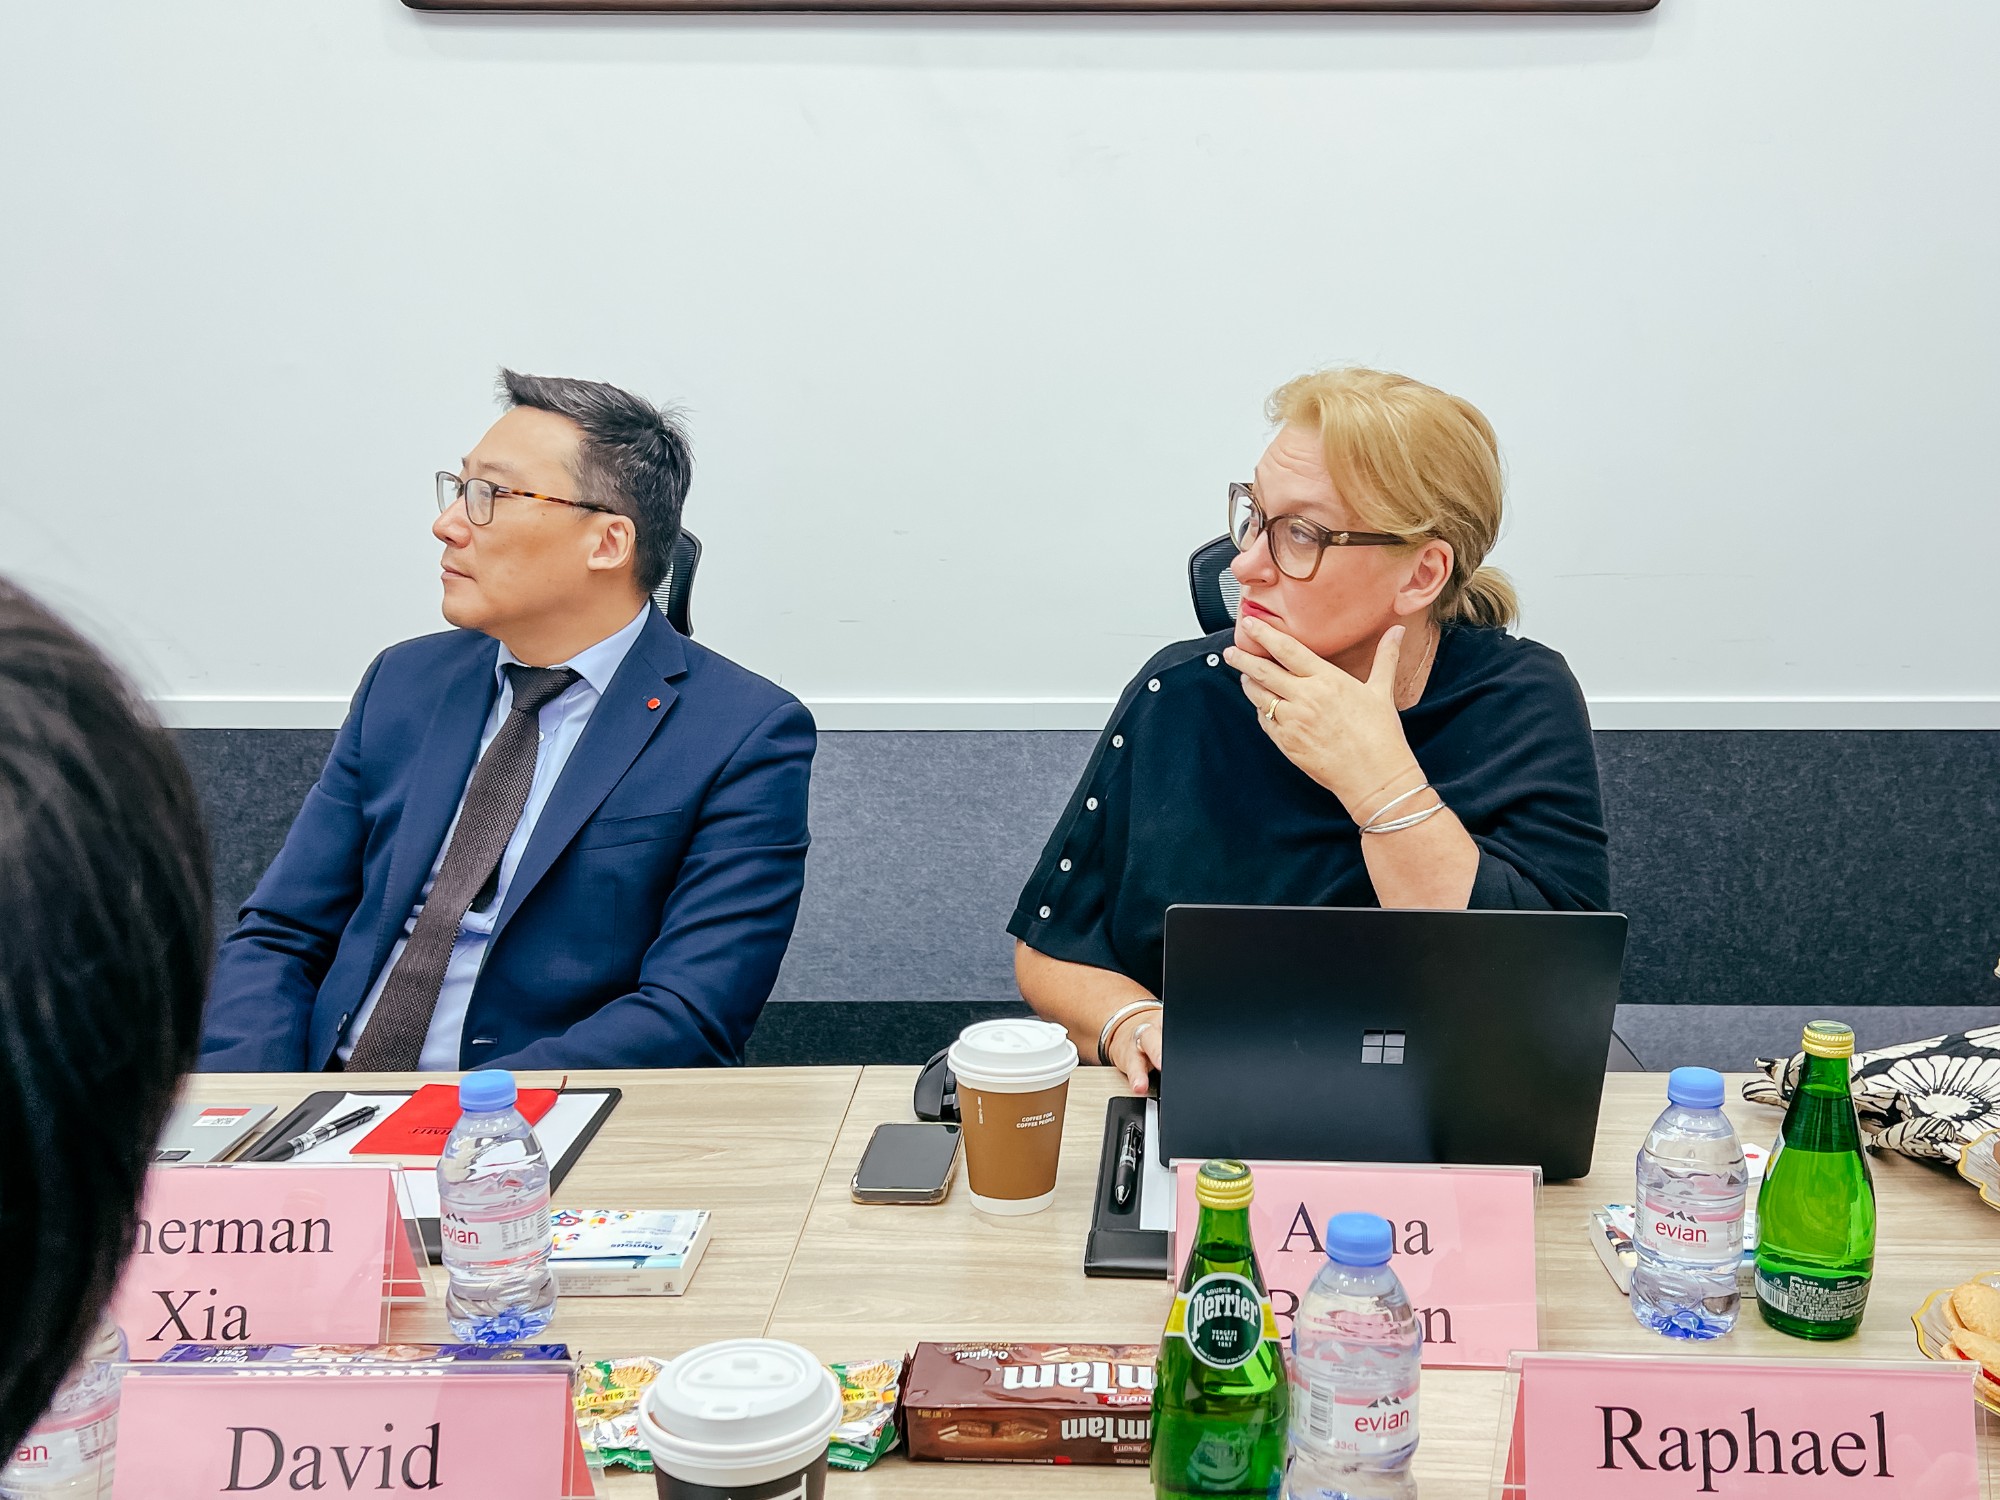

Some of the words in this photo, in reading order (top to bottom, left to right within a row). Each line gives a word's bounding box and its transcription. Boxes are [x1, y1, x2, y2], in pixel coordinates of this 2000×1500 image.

[1016, 1120, 1038, 1129] COFFEE
[1038, 1116, 1056, 1126] PEOPLE
[1021, 1114, 1042, 1123] COFFEE
[138, 1218, 334, 1255] erman
[442, 1223, 479, 1244] evian
[1277, 1201, 1434, 1255] Aa
[1655, 1222, 1707, 1243] evian
[1206, 1287, 1231, 1296] SOURCE
[146, 1288, 252, 1341] Xia
[956, 1349, 1008, 1361] Original
[1002, 1361, 1158, 1394] mTam
[1061, 1416, 1151, 1443] mTam
[1354, 1409, 1410, 1433] evian
[219, 1422, 443, 1491] David
[1595, 1406, 1895, 1492] Raphael
